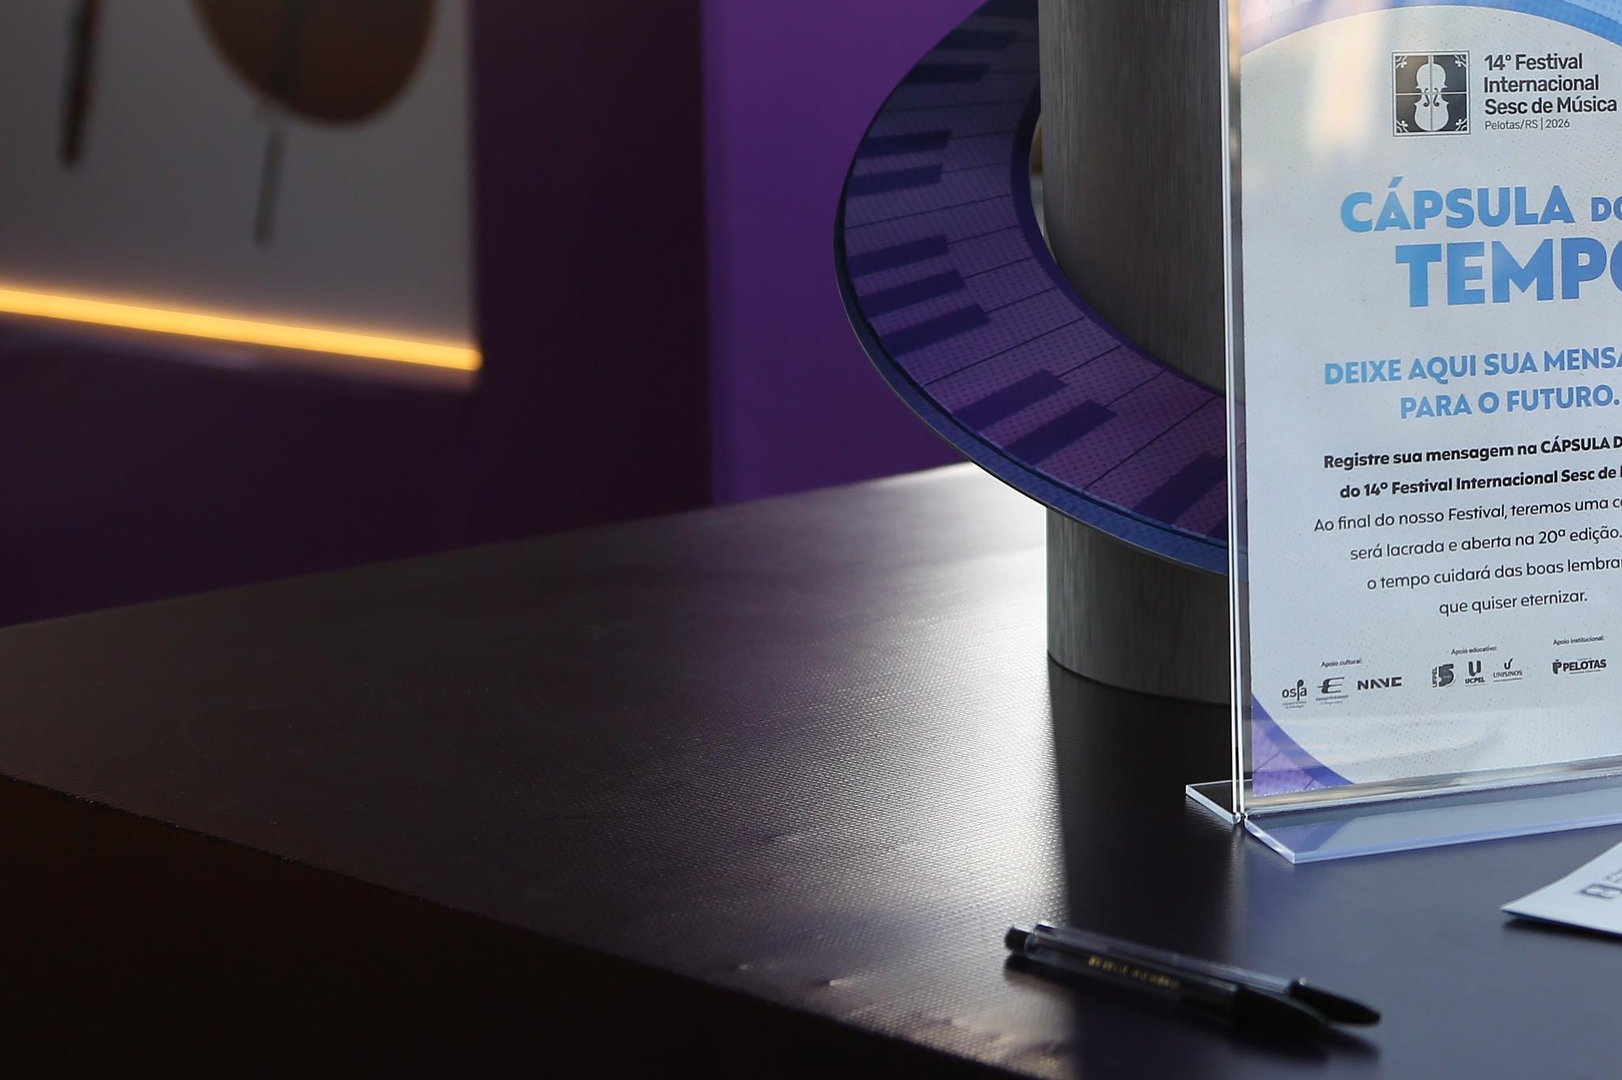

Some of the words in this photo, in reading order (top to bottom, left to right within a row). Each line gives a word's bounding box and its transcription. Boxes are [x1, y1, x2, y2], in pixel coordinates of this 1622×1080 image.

[1515, 53, 1583, 70] Festival
[1484, 74, 1599, 93] Internacional
[1484, 98, 1528, 115] Sesc
[1531, 98, 1554, 114] de
[1557, 96, 1618, 113] Música
[1484, 119, 1538, 131] Pelotas/RS
[1545, 118, 1571, 129] 2026
[1340, 176, 1576, 233] CÁPSULA
[1324, 359, 1402, 385] DEIXE
[1408, 355, 1477, 385] AQUI
[1484, 351, 1538, 376] SUA
[1401, 393, 1472, 419] PARA
[1477, 391, 1500, 414] O
[1507, 384, 1620, 412] FUTURO.
[1324, 452, 1390, 470] Registre
[1393, 452, 1423, 464] sua
[1426, 445, 1514, 462] mensagem
[1517, 443, 1537, 456] na
[1540, 435, 1611, 453] CÁPSULA
[1339, 484, 1361, 498] do
[1392, 478, 1453, 495] Festival
[1456, 470, 1558, 490] Internacional
[1561, 469, 1595, 482] Sesc
[1598, 466, 1617, 480] de
[1313, 518, 1334, 532] Ao
[1338, 514, 1371, 530] final
[1374, 512, 1395, 527] do
[1399, 512, 1444, 525] nosso
[1448, 504, 1508, 521] Festival,
[1511, 501, 1571, 517] teremos
[1575, 499, 1609, 511] uma
[1350, 543, 1383, 560] será
[1386, 540, 1445, 557] lacrada
[1448, 541, 1458, 552] e
[1461, 536, 1511, 551] aberta
[1515, 534, 1534, 547] na
[1569, 525, 1622, 545] edição.
[1366, 579, 1377, 590] o
[1380, 573, 1430, 589] tempo
[1433, 565, 1490, 584] cuidará
[1494, 564, 1523, 579] das
[1526, 562, 1564, 576] boas
[1439, 601, 1468, 617] que
[1471, 596, 1518, 615] quiser
[1520, 590, 1588, 607] eternizar.
[1492, 670, 1523, 678] UNISINOS
[1562, 659, 1607, 672] PELOTAS
[1357, 676, 1402, 691] NAVE
